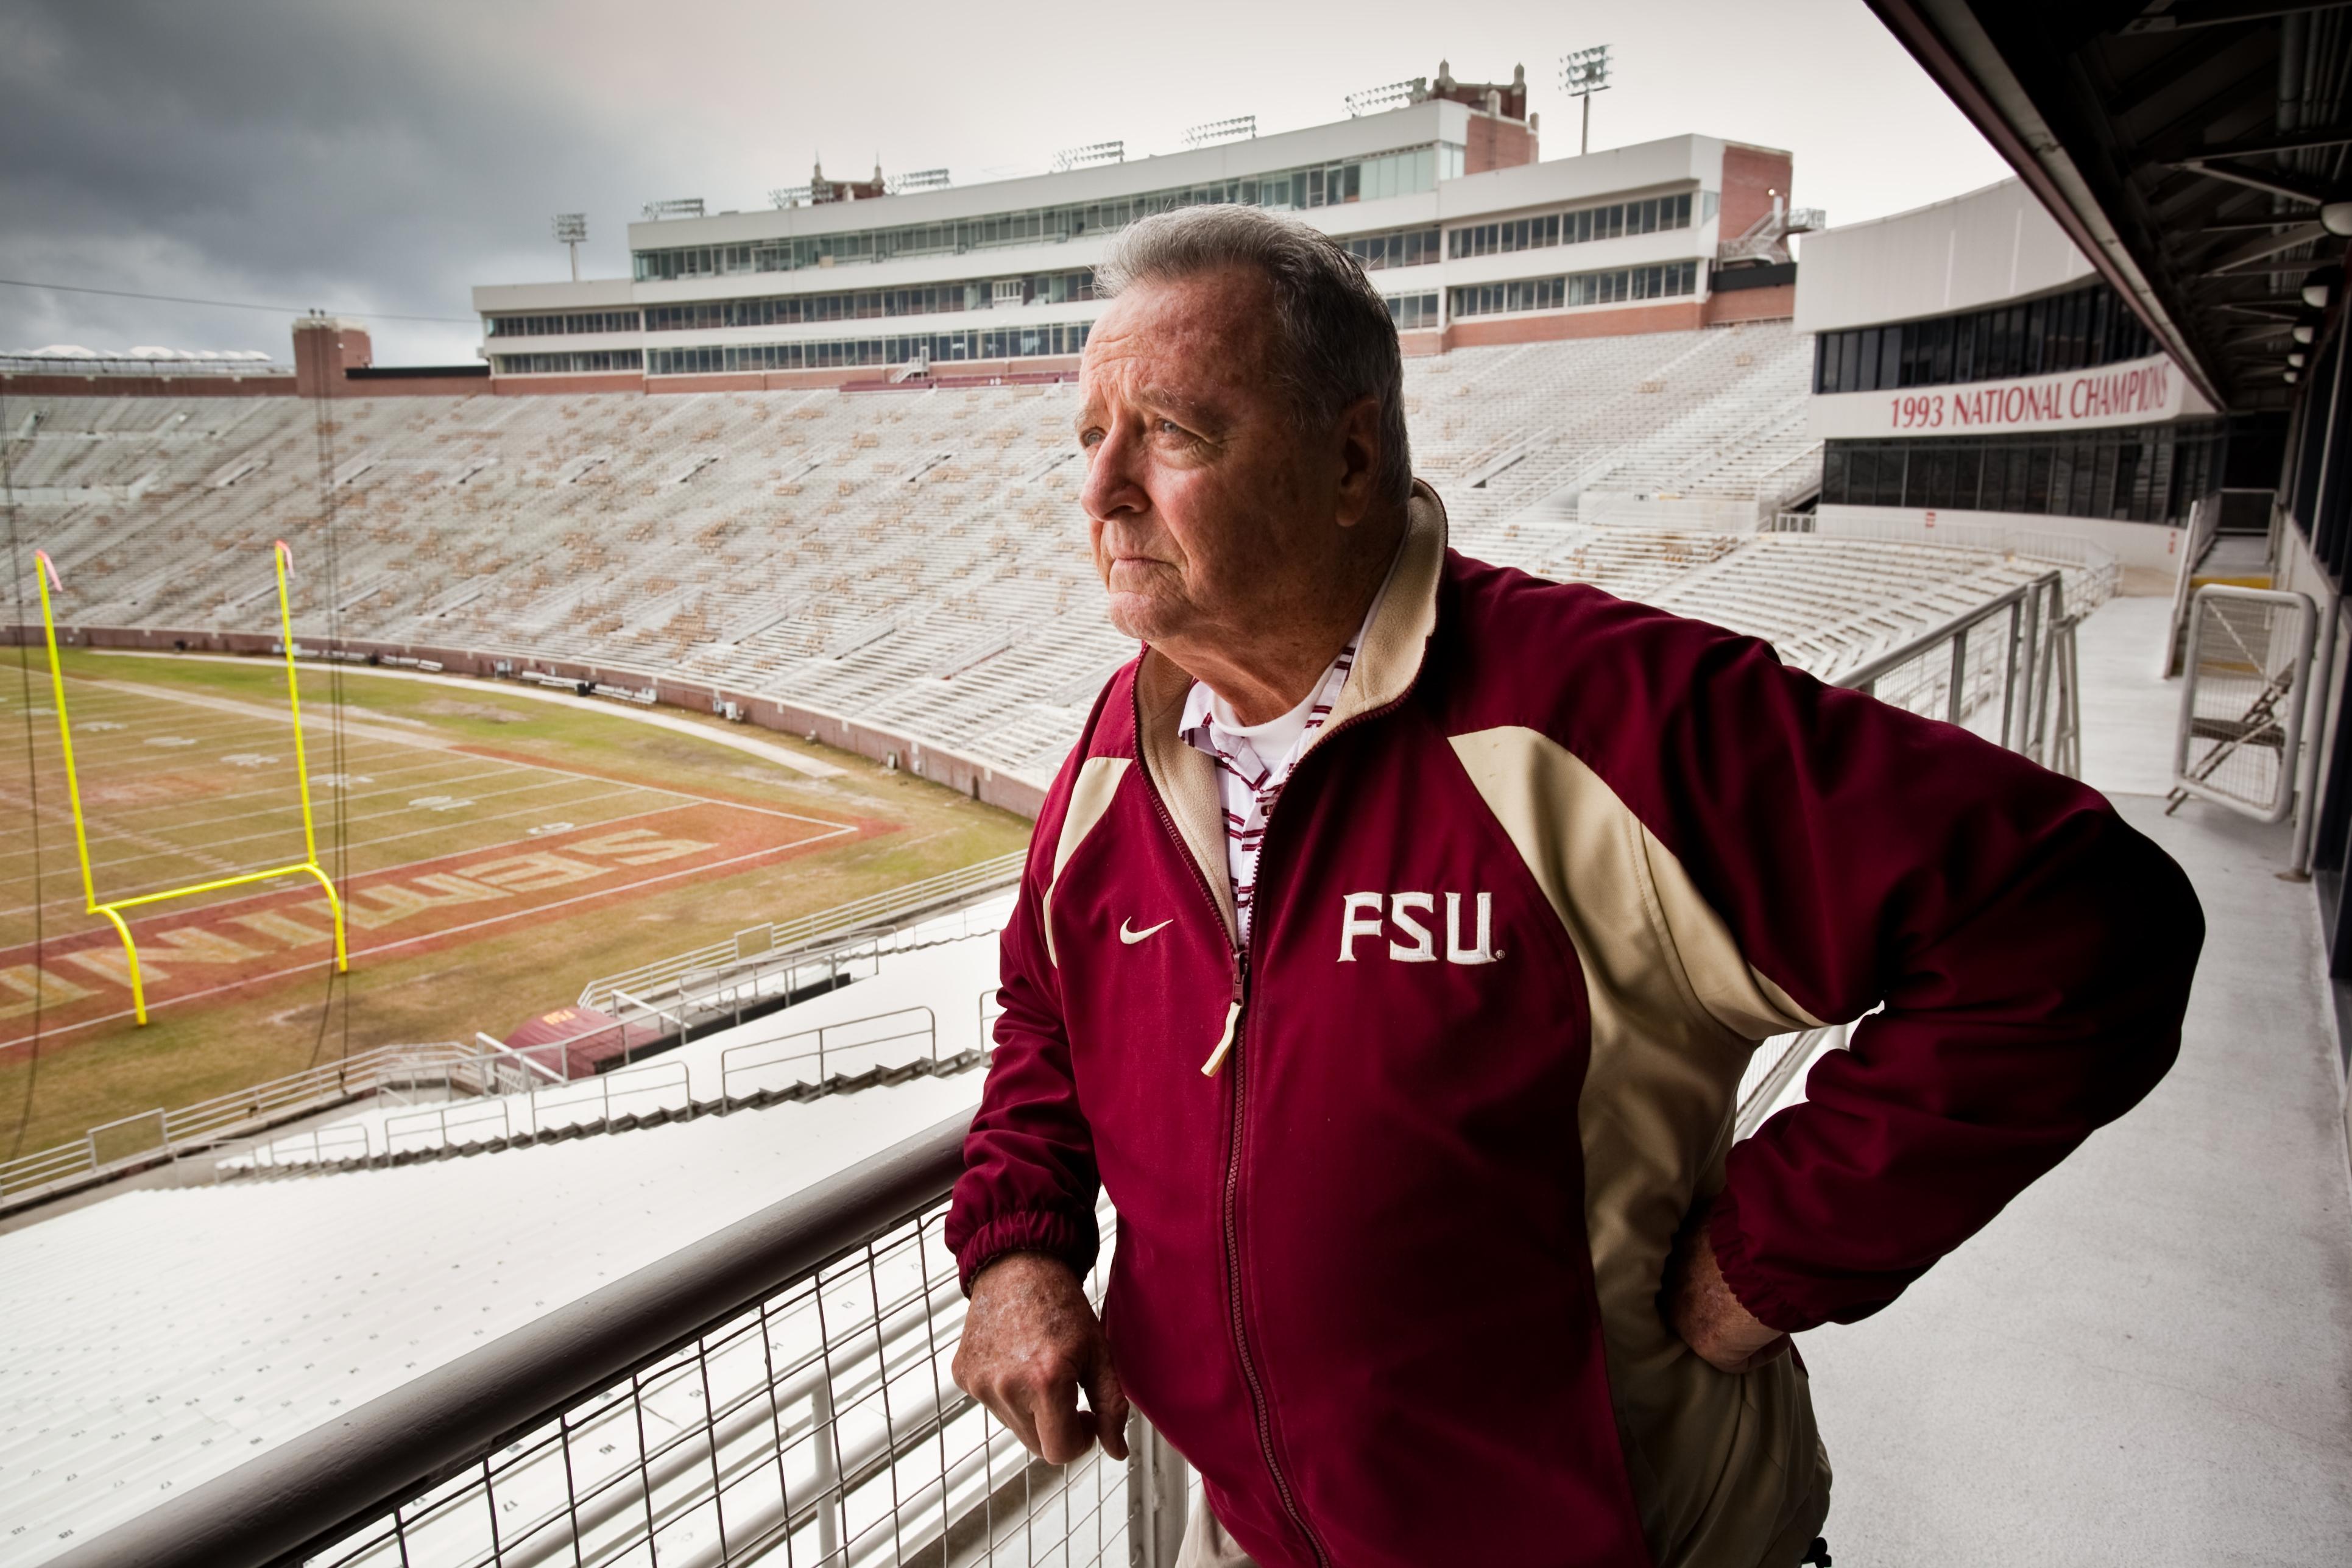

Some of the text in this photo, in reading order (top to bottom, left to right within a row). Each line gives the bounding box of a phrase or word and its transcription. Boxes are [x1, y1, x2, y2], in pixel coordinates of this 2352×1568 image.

[1891, 395, 1944, 427] 1993
[1952, 382, 2062, 426] NATIONAL
[1337, 891, 1497, 965] FSU
